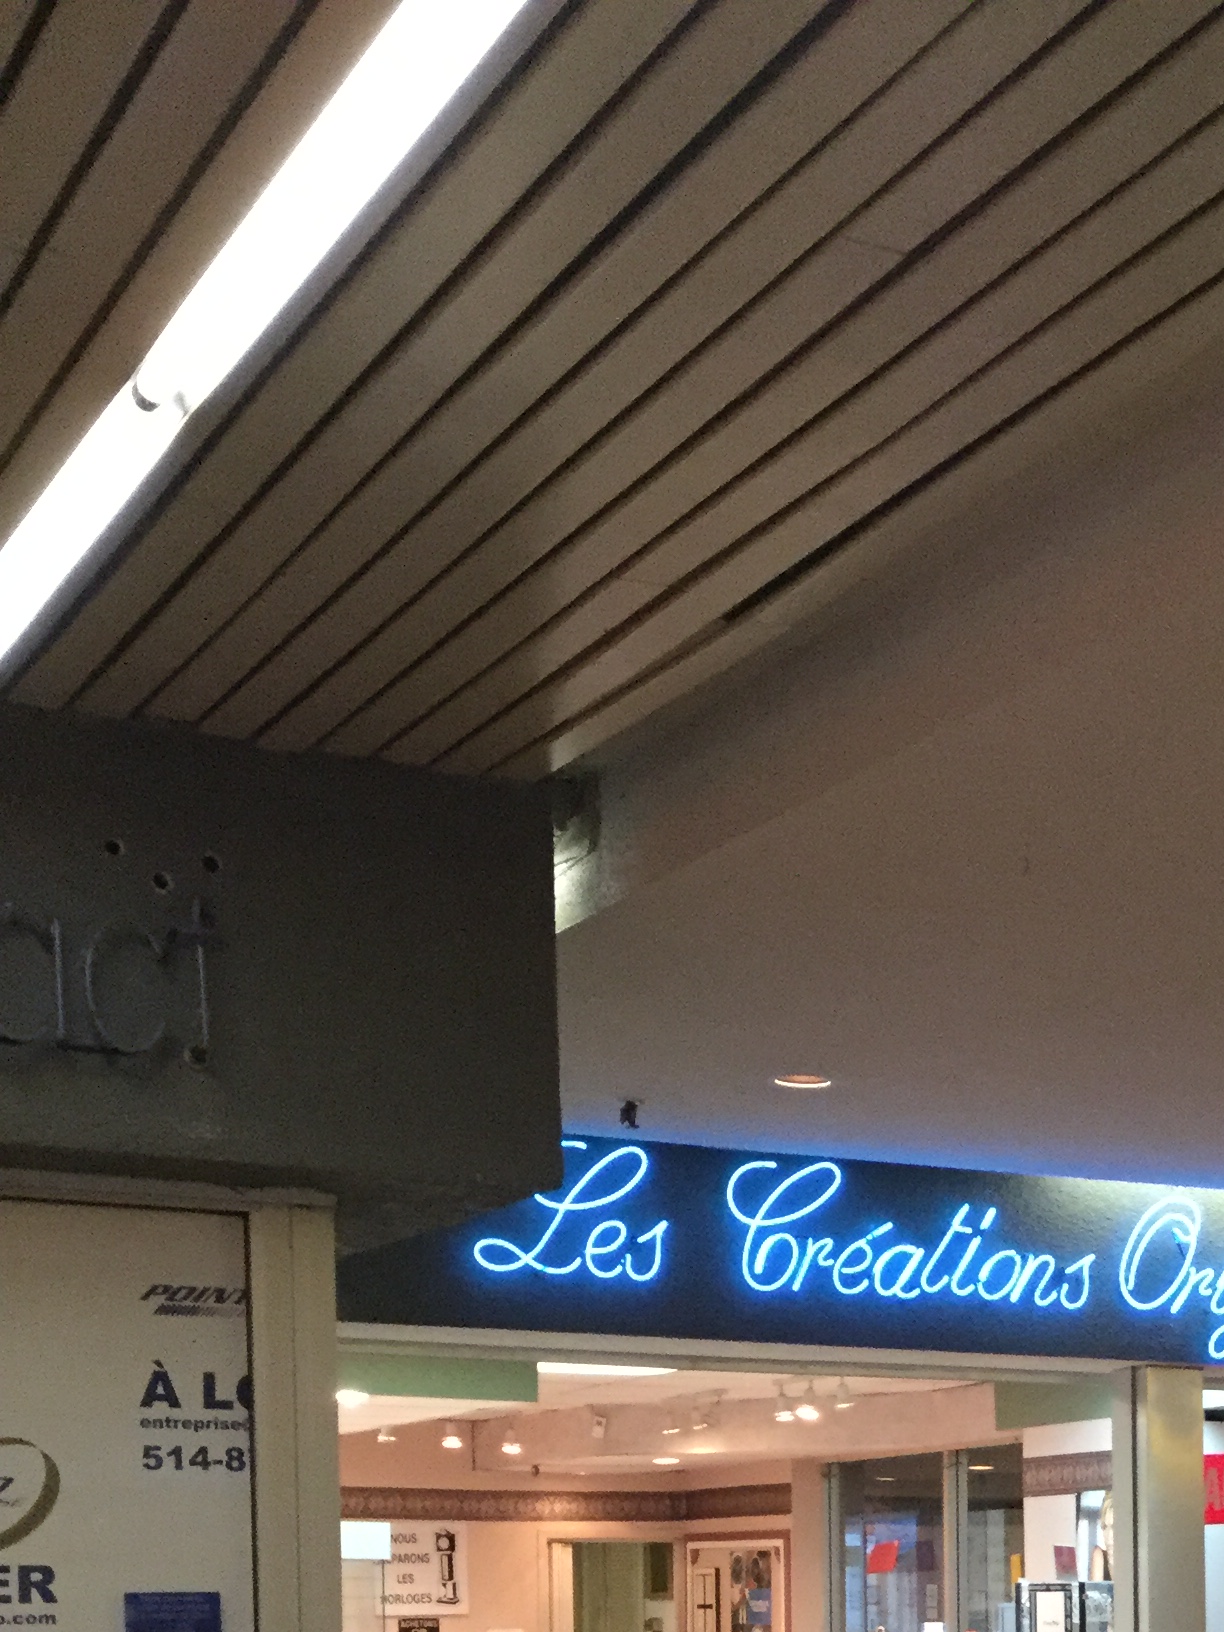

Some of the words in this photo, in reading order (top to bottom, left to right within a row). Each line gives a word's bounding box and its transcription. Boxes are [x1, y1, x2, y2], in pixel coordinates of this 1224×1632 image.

[474, 1140, 668, 1281] Les
[727, 1161, 1096, 1310] Créations
[140, 1359, 181, 1409] À
[397, 1573, 415, 1584] LES
